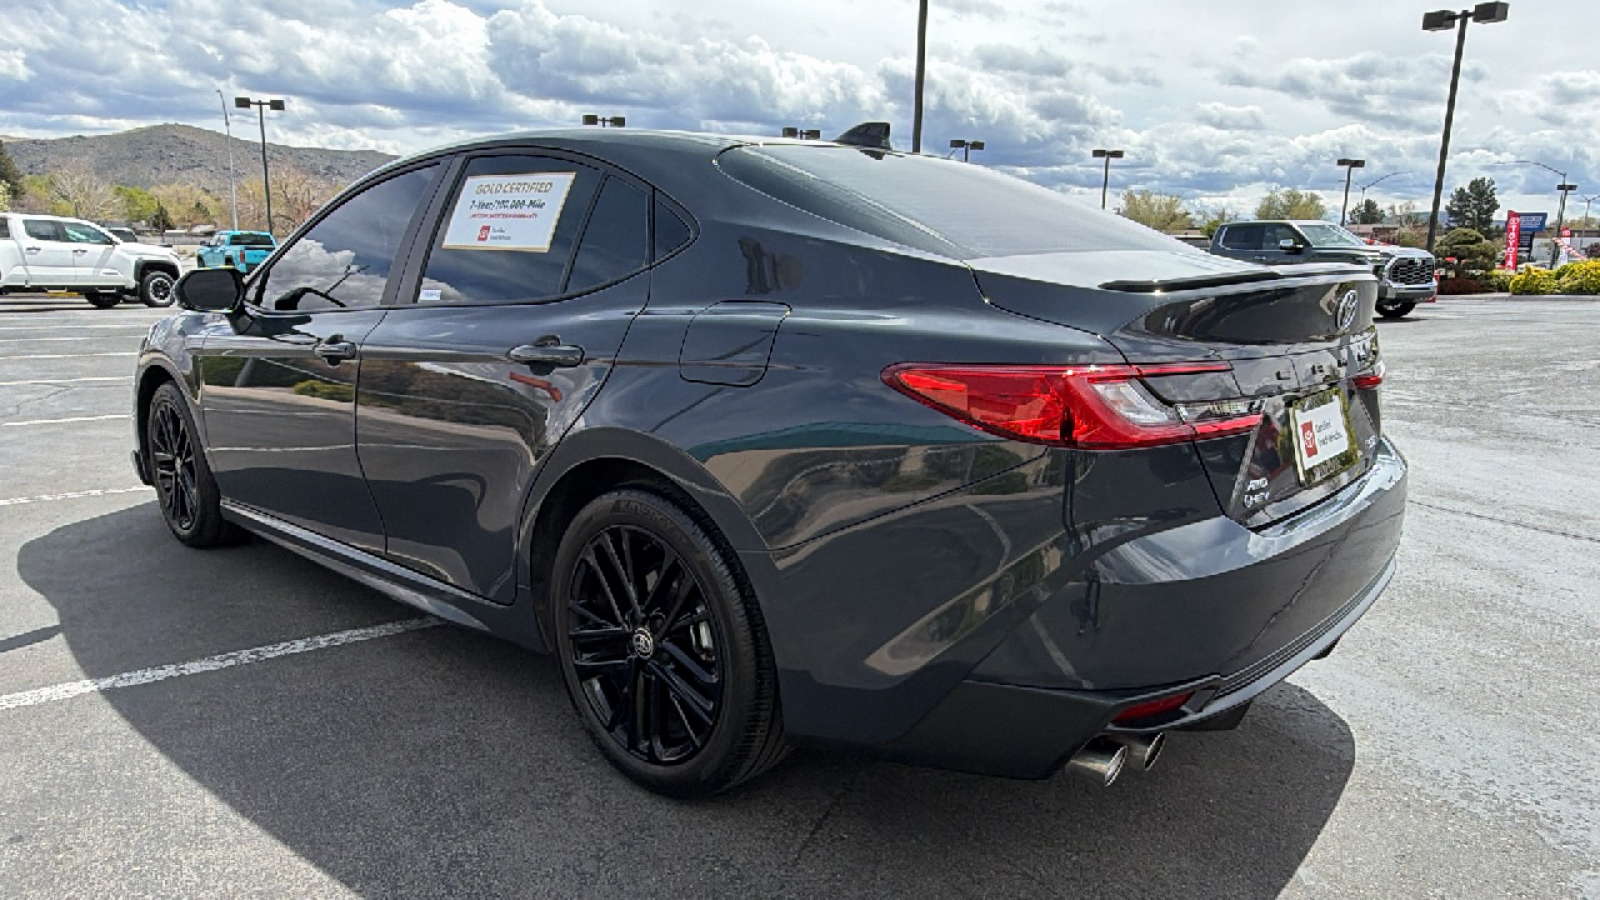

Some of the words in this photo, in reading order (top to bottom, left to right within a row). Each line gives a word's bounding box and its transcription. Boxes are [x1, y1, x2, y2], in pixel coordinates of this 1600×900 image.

[475, 183, 502, 195] GOLD
[503, 182, 553, 194] CERTIFIED
[1505, 225, 1516, 267] TOYOTA
